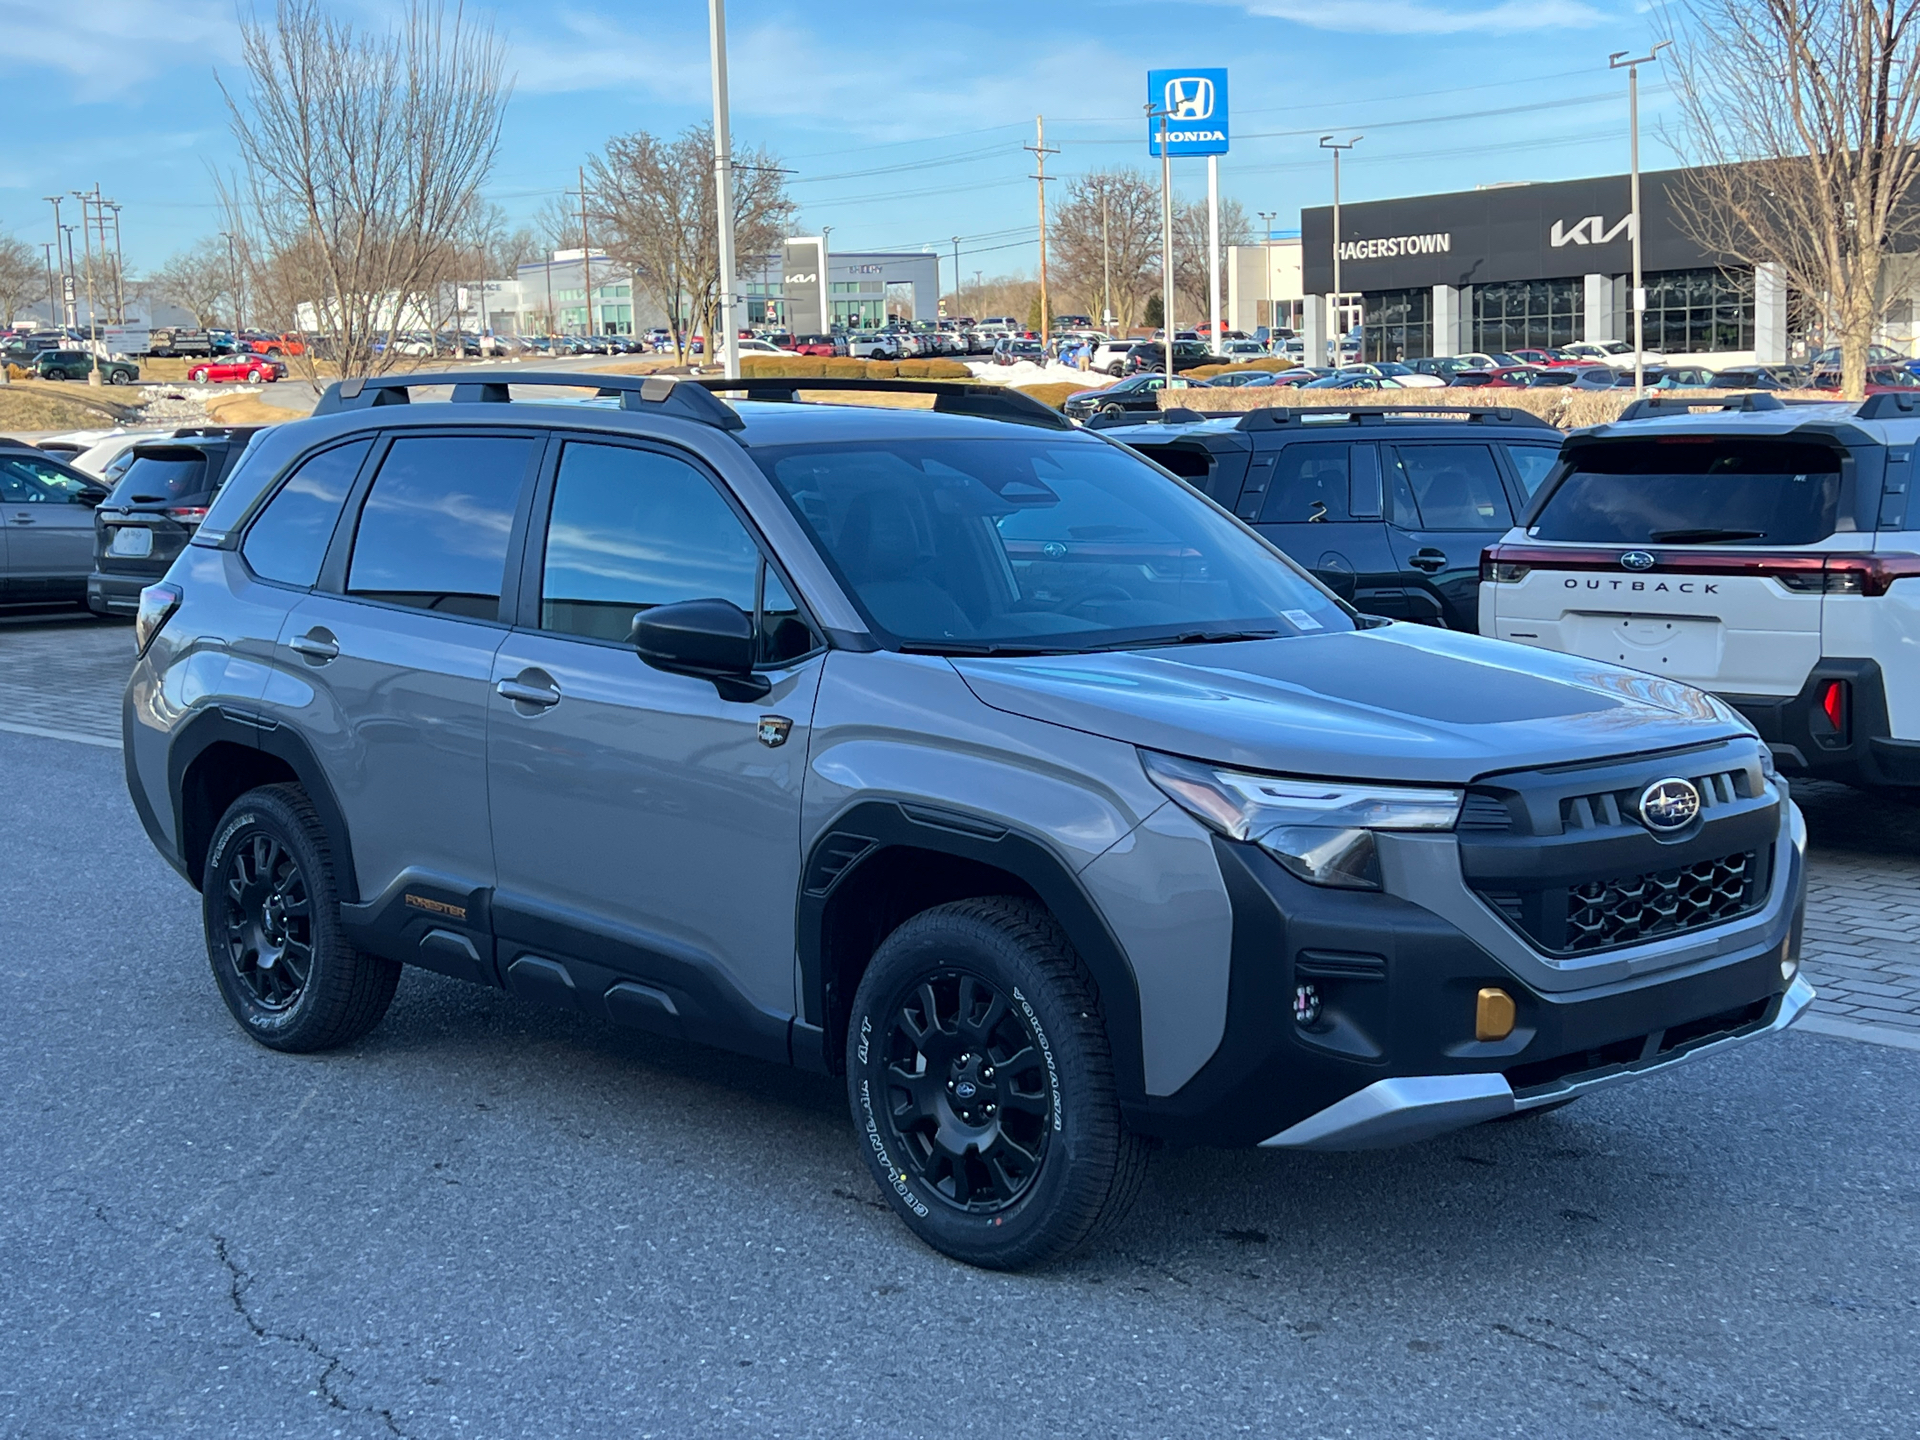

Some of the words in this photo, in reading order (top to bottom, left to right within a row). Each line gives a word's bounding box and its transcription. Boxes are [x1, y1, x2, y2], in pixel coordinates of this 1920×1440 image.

[1154, 131, 1226, 143] HONDA
[1333, 233, 1450, 260] HAGERSTOWN
[785, 273, 817, 283] KIA
[1564, 579, 1719, 594] OUTBACK
[405, 893, 466, 918] FORESTER
[1013, 986, 1061, 1131] YOKOHAMA
